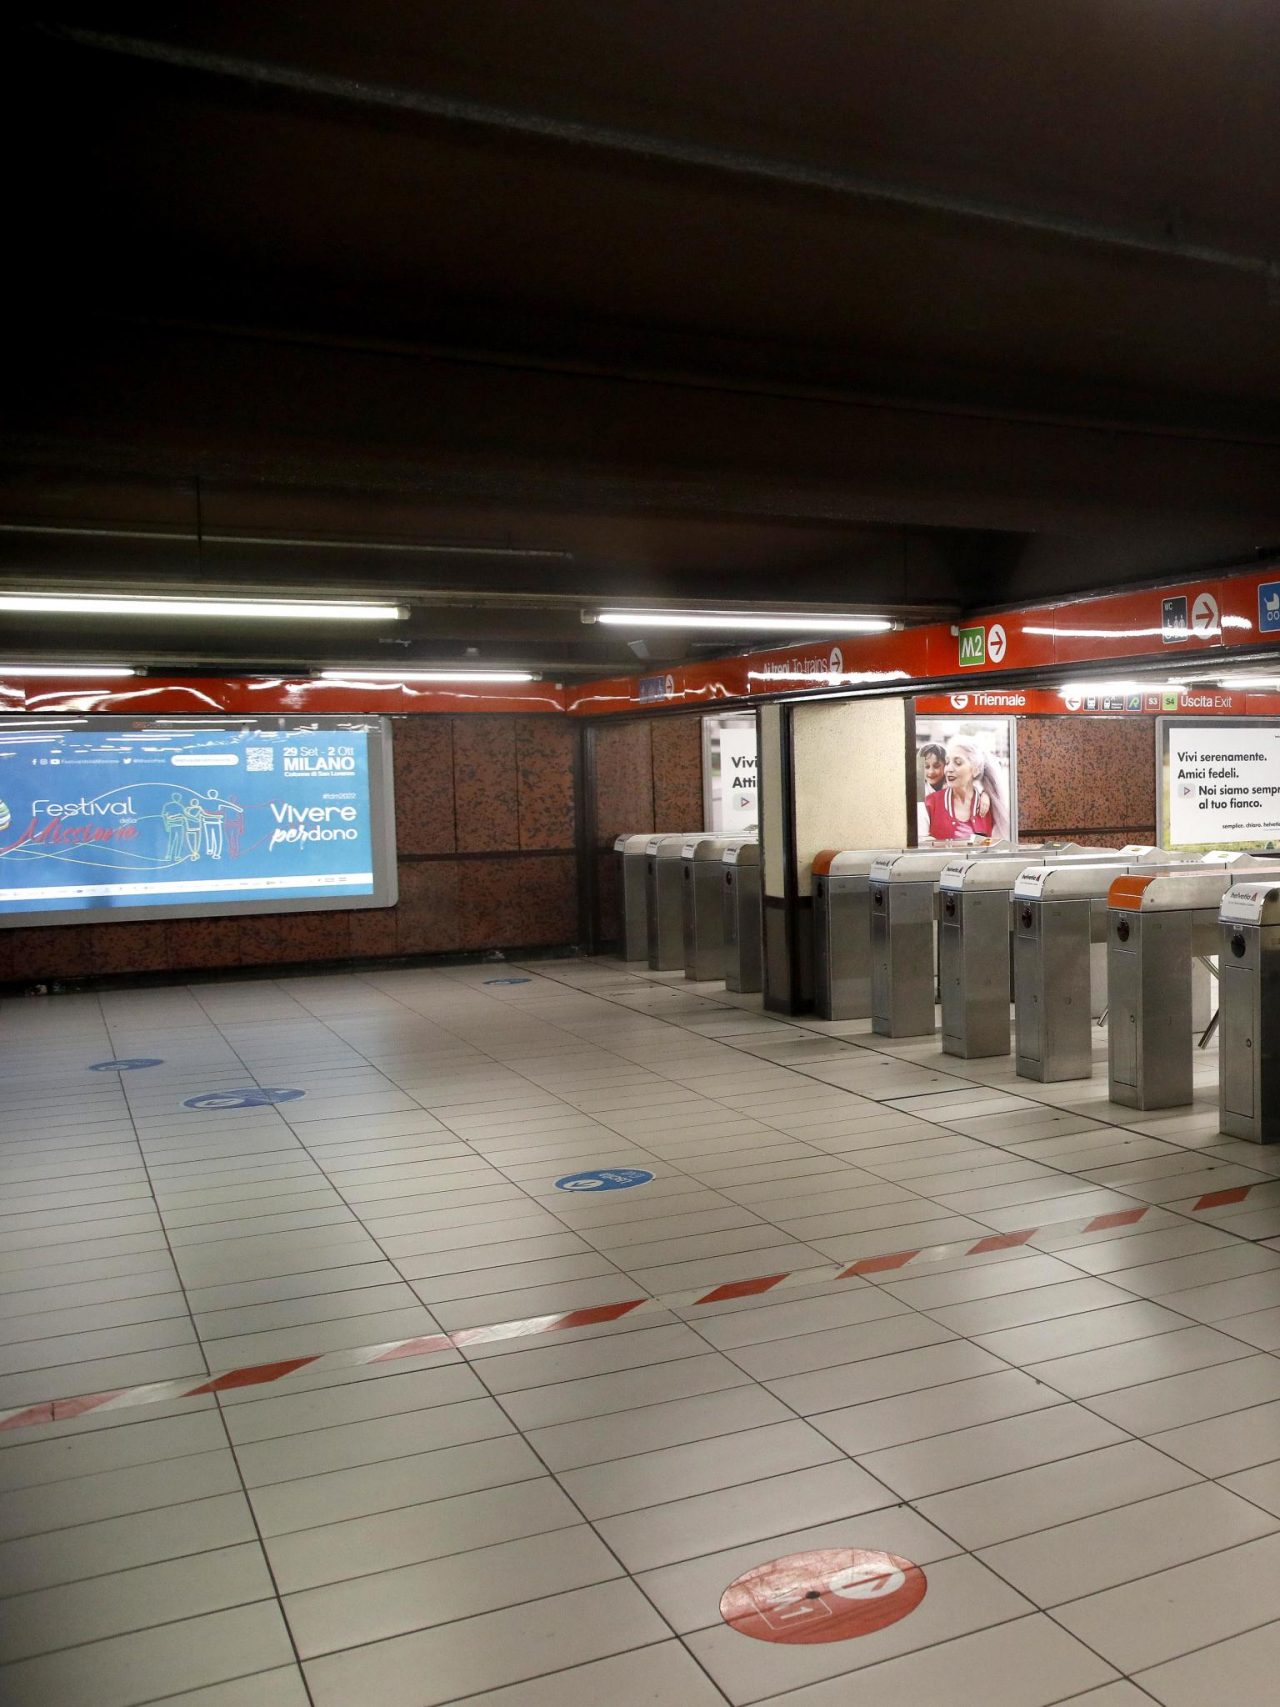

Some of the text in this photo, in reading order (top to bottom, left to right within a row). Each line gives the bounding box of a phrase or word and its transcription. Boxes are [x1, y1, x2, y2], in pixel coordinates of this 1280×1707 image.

[962, 635, 982, 658] M2
[974, 693, 1025, 706] Triennale
[1165, 697, 1175, 705] S4
[1181, 695, 1213, 708] Uscita
[1214, 696, 1232, 708] Exit
[283, 747, 298, 756] 29
[300, 746, 318, 756] Set
[328, 746, 336, 756] 2
[1177, 751, 1268, 762] Vivi serenamente.
[284, 756, 355, 771] MILANO
[1177, 768, 1239, 779] Amici fedeli.
[1199, 785, 1217, 795] Noi
[1219, 785, 1249, 795] siamo
[32, 796, 137, 817] Festival
[1198, 798, 1262, 809] al tuo fianco.
[270, 803, 357, 823] Vivere
[269, 825, 358, 852] perdono
[1230, 892, 1251, 901] helvetia
